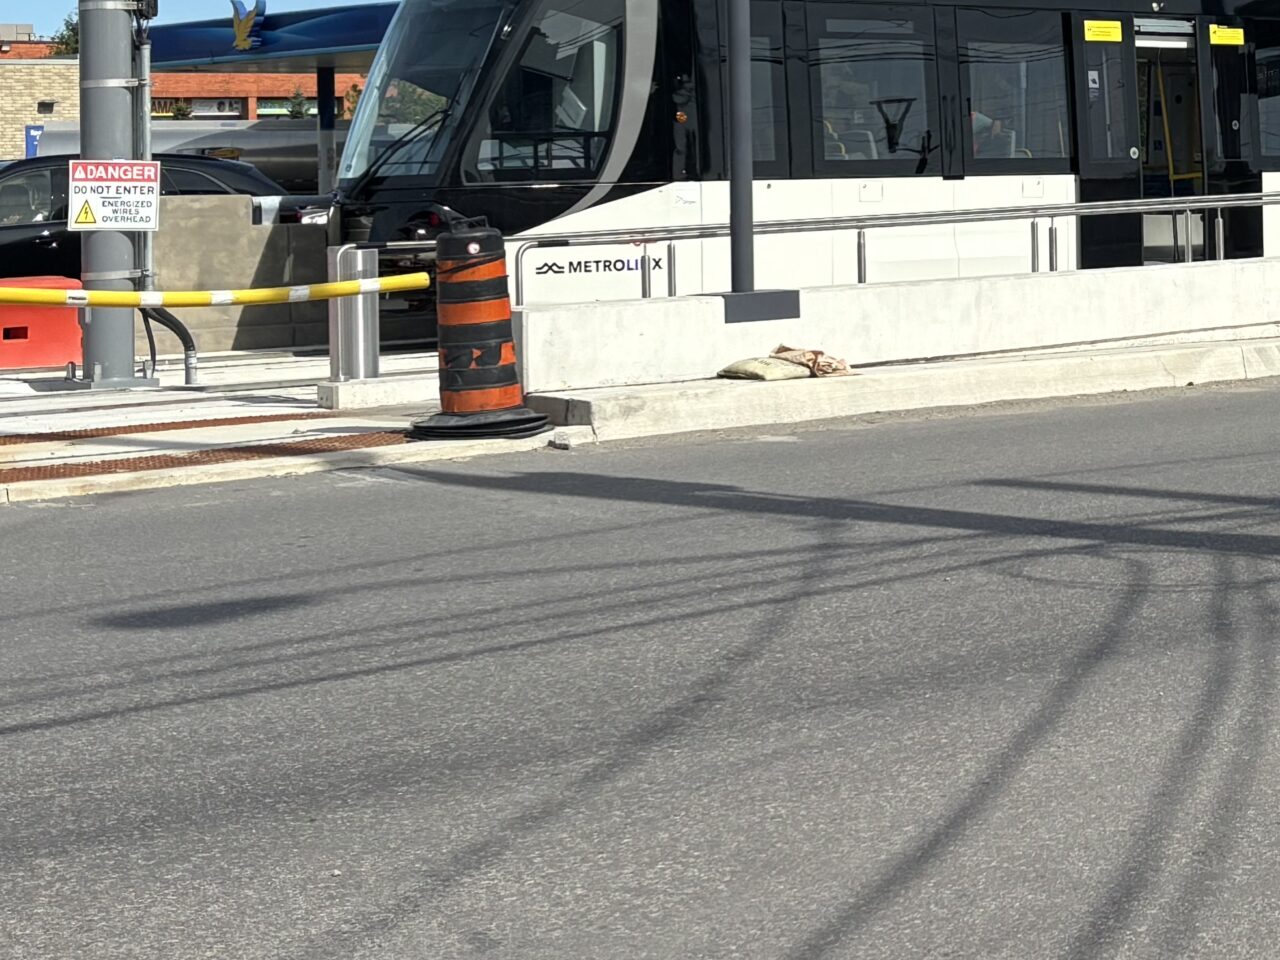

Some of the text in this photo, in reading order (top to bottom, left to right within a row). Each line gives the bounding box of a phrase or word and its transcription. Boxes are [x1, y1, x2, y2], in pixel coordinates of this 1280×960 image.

[87, 165, 155, 180] DANGER
[73, 185, 155, 195] DO NOT ENTER
[101, 200, 152, 208] ENERGIZED
[101, 215, 151, 223] OVERHEAD
[568, 257, 663, 274] METROLIX
